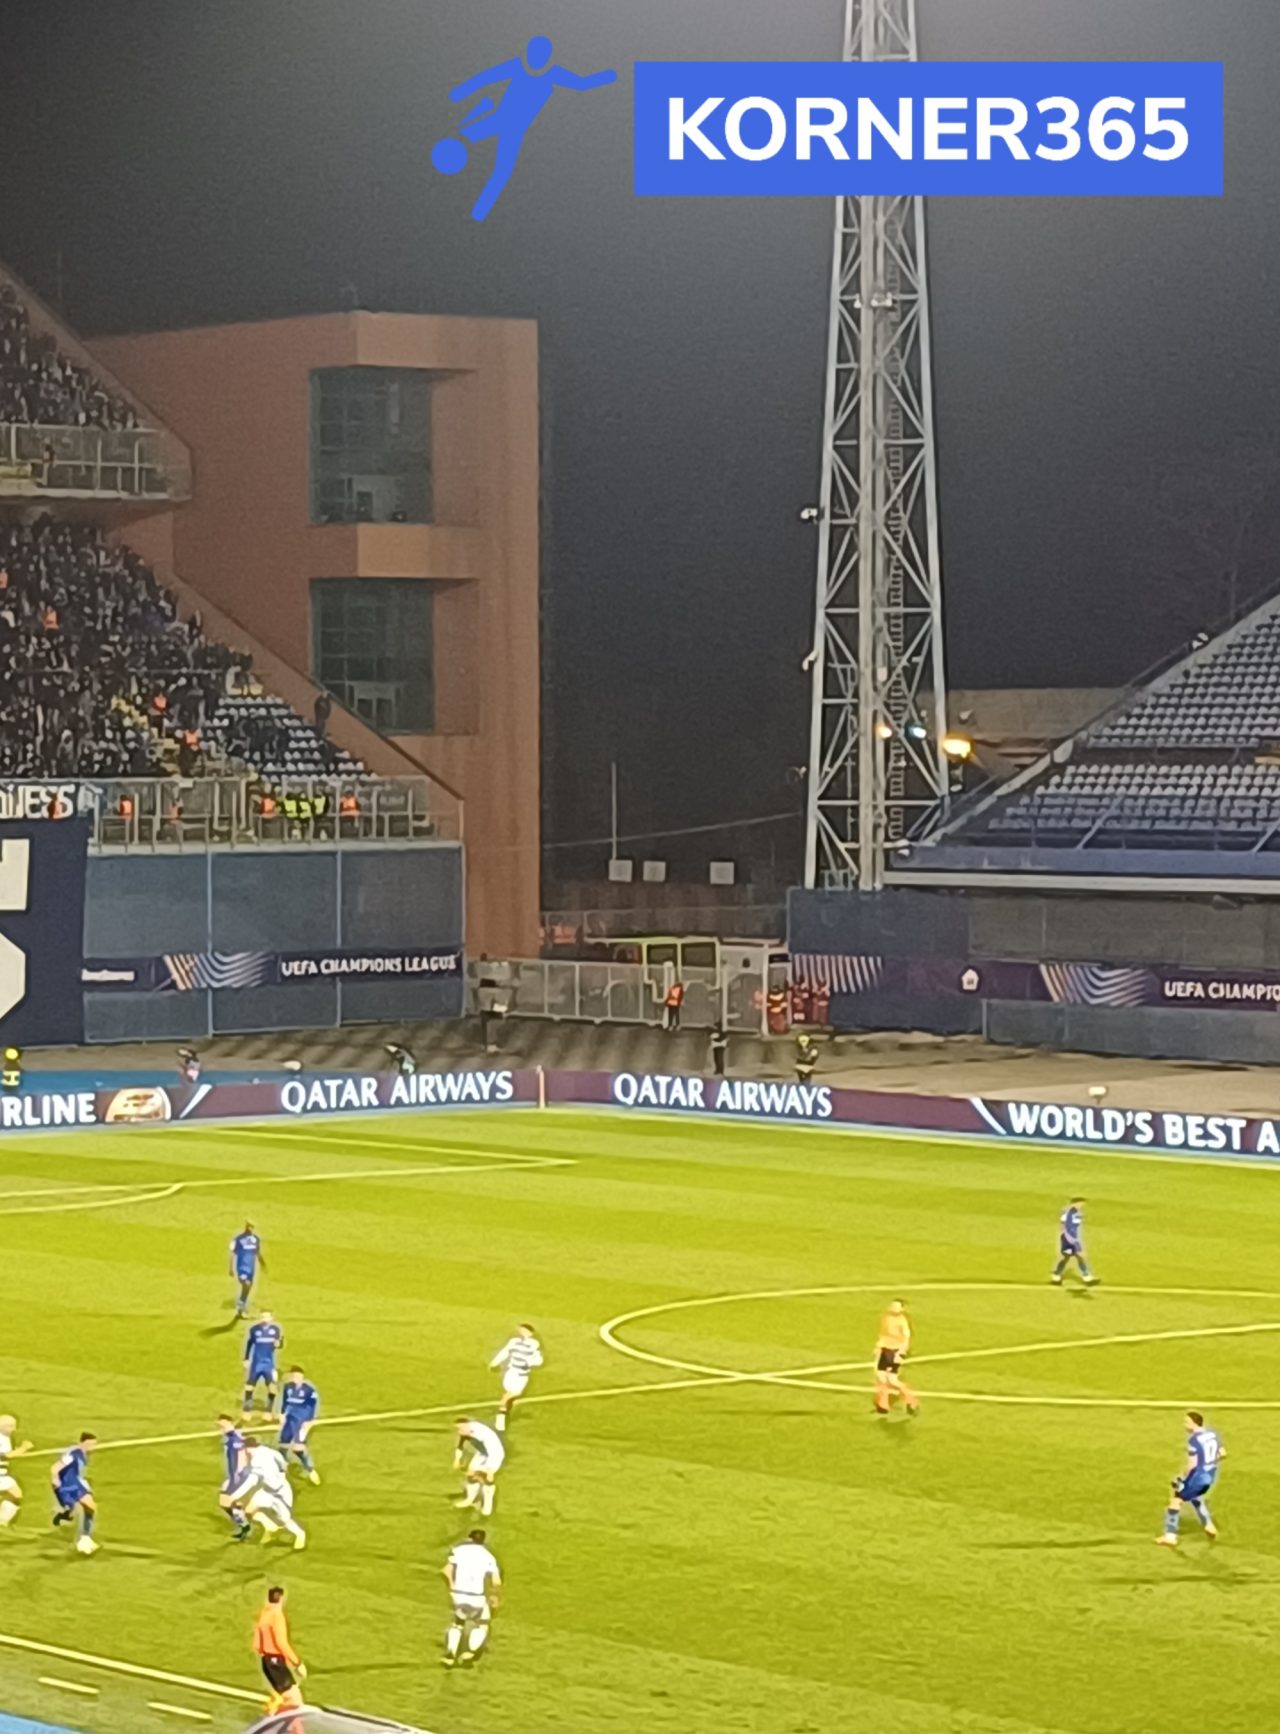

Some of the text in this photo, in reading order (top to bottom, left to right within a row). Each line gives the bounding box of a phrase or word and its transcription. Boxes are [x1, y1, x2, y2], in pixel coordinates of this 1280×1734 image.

[281, 954, 457, 976] UEFA CHAMPIONS LEAGUE
[1164, 981, 1205, 998] UEFA
[280, 1070, 514, 1113] QATAR AIRWAYS
[614, 1073, 833, 1117] QATAR AIRWAYS
[1007, 1102, 1280, 1153] WORLD'S BEST A
